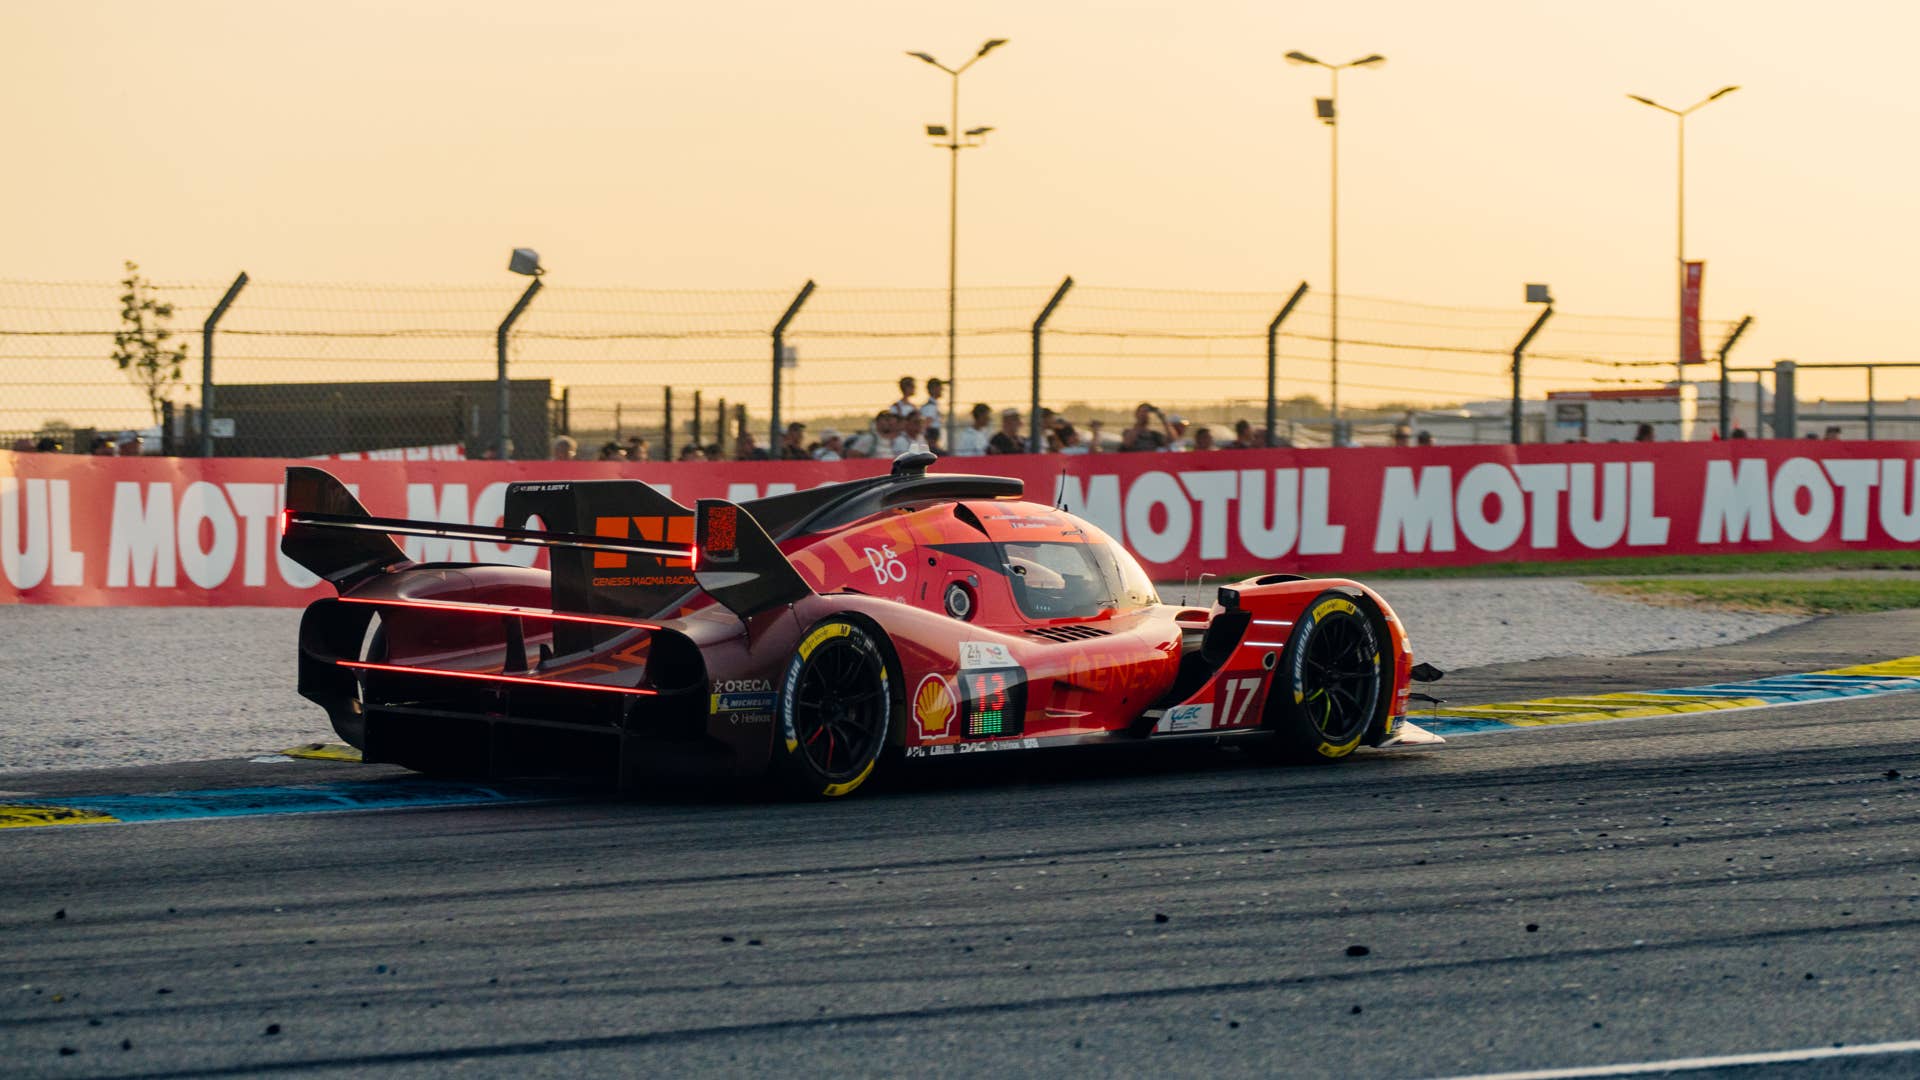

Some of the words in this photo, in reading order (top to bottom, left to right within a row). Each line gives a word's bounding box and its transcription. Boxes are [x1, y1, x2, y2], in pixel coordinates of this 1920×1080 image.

[1054, 467, 1345, 564] MOTUL
[1374, 462, 1670, 553] MOTUL
[593, 576, 630, 586] GENESIS
[632, 575, 664, 585] MAGMA
[666, 575, 697, 585] RACIN
[1294, 620, 1313, 680] MICHELIN
[724, 679, 772, 693] ORECA
[784, 659, 801, 727] MICHELIN
[975, 674, 1005, 712] 13
[1219, 677, 1262, 726] 17
